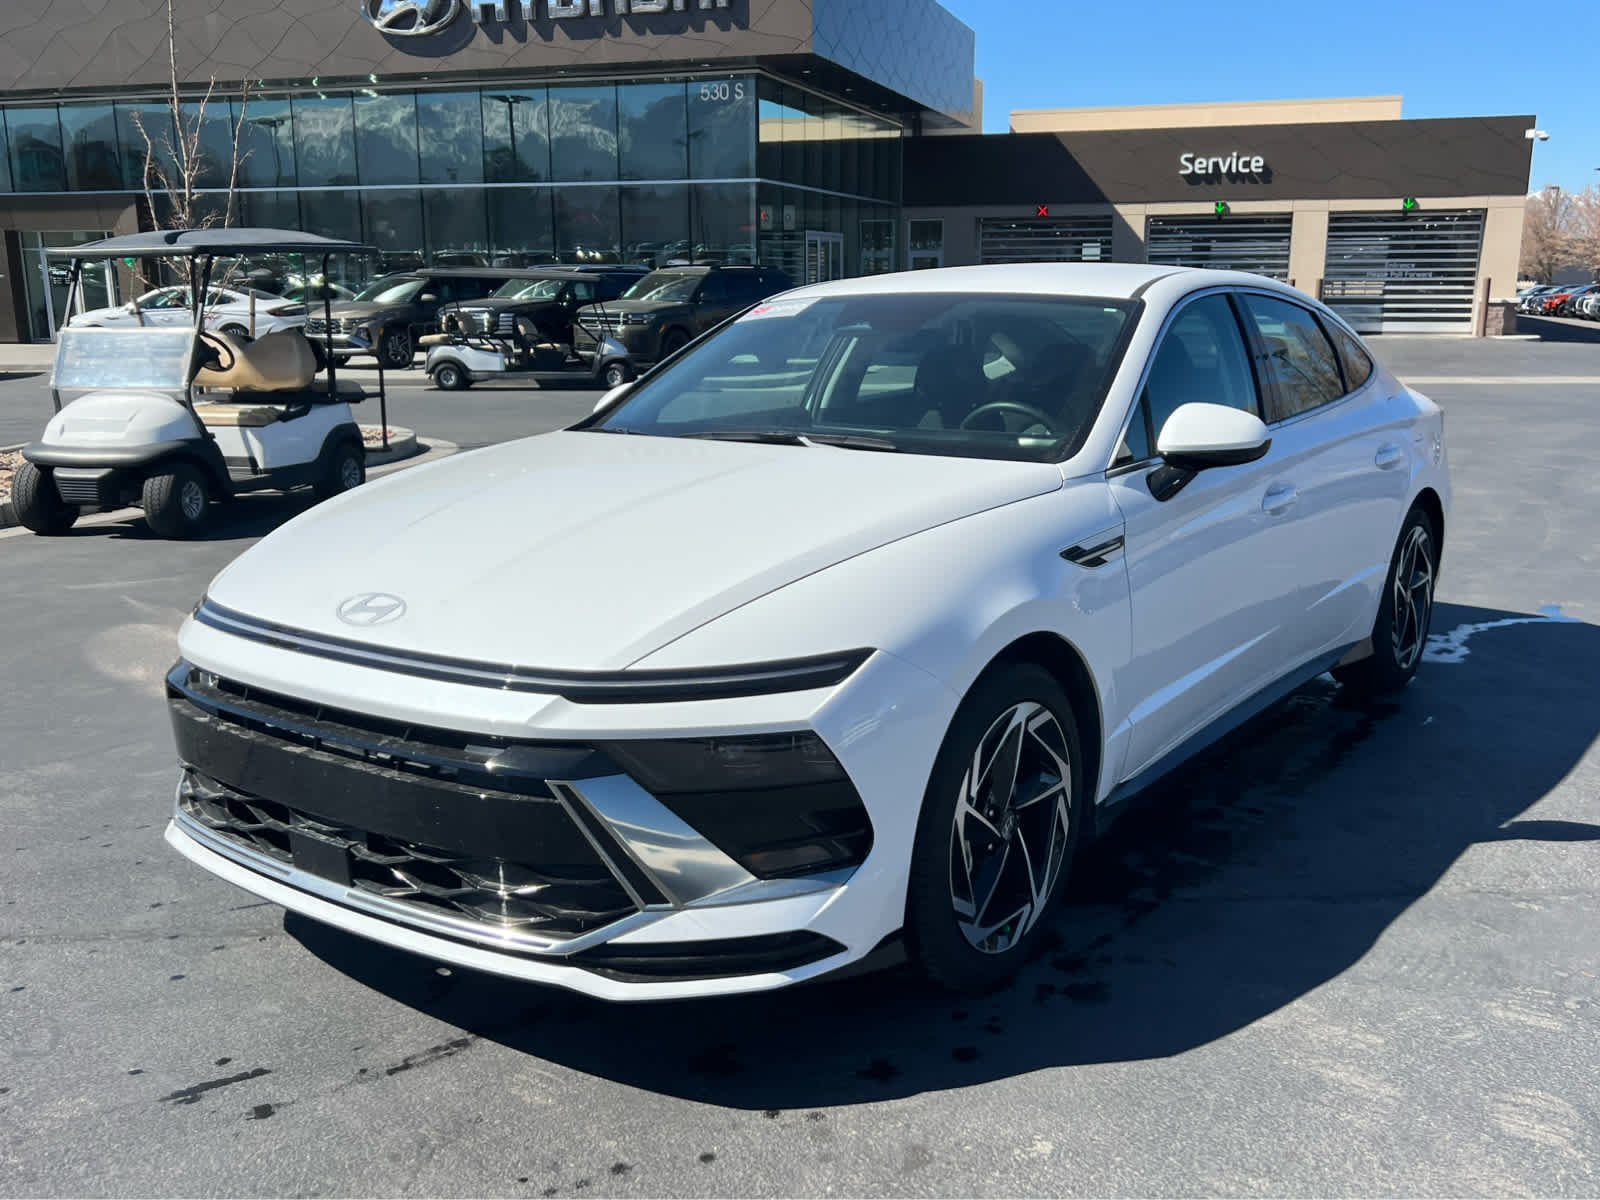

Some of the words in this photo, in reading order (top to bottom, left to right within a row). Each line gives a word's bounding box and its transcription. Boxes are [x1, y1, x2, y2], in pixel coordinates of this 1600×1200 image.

[700, 83, 729, 101] 530
[734, 82, 744, 100] S
[1179, 151, 1265, 175] Service
